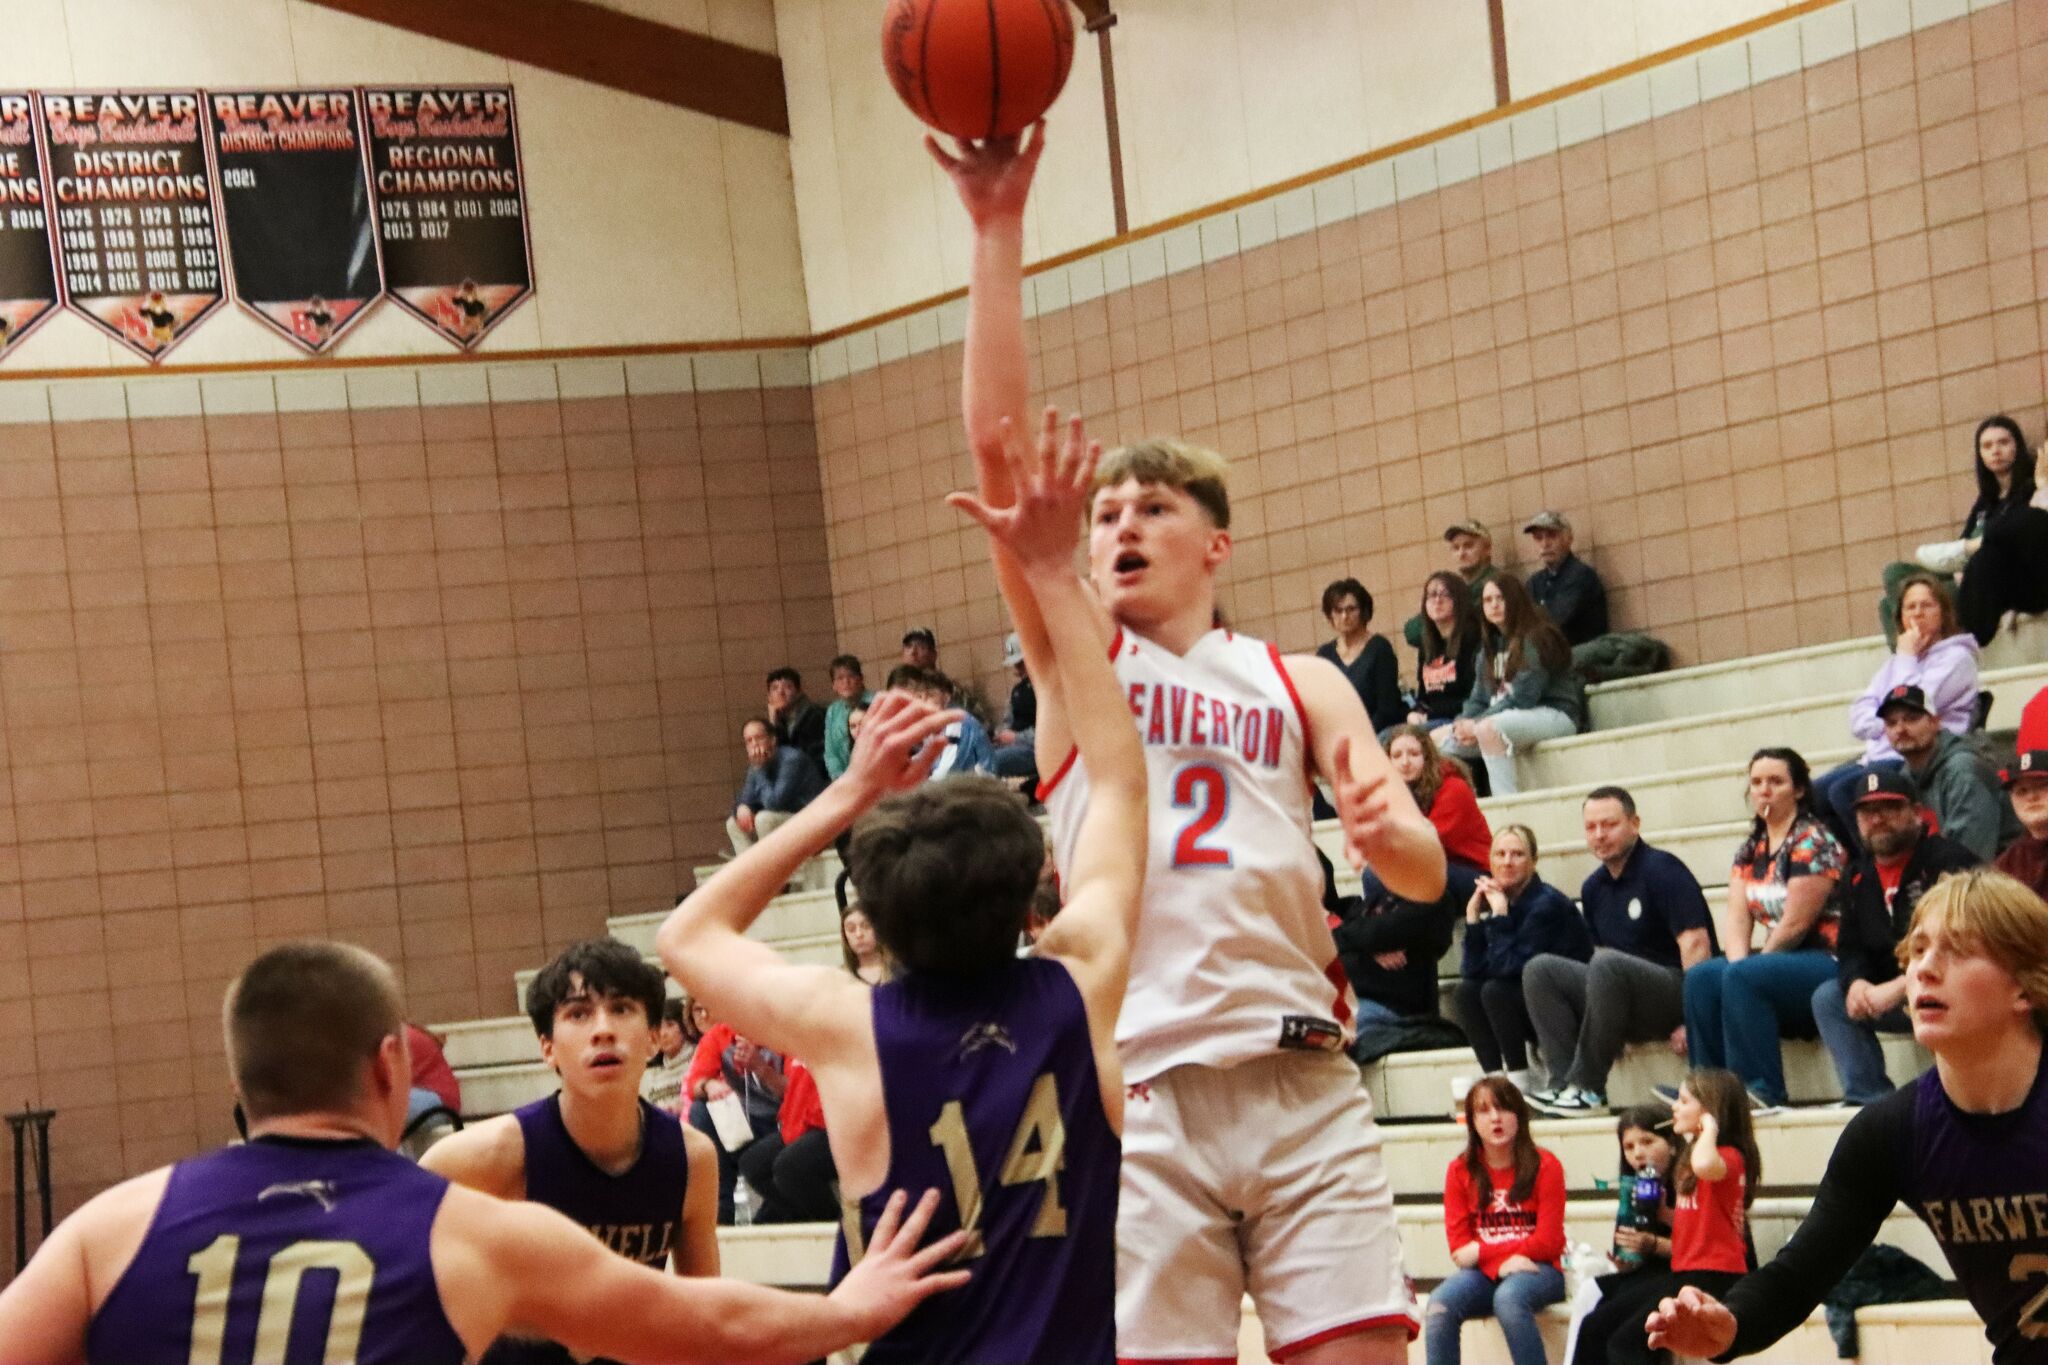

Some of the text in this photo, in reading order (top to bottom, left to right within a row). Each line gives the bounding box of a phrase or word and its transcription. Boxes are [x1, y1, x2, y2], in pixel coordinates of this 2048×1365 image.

[44, 96, 197, 121] BEAVER
[214, 93, 349, 120] BEAVER
[368, 91, 508, 116] BEAVER
[220, 128, 354, 153] DISTRICT CHAMPIONS
[74, 151, 181, 177] DISTRICT
[389, 145, 498, 168] REGIONAL
[57, 174, 207, 202] CHAMPIONS
[224, 168, 256, 188] 2021
[378, 168, 516, 194] CHAMPIONS
[454, 200, 484, 217] 2001
[490, 199, 519, 217] 2002
[383, 221, 449, 240] 2013 2017
[106, 250, 138, 270] 2001
[184, 248, 216, 268] 2013
[187, 269, 218, 290] 2017
[1128, 683, 1284, 768] EAVERTON
[1172, 763, 1232, 869] 2
[929, 1072, 1068, 1262] 14
[187, 1234, 376, 1365] 10
